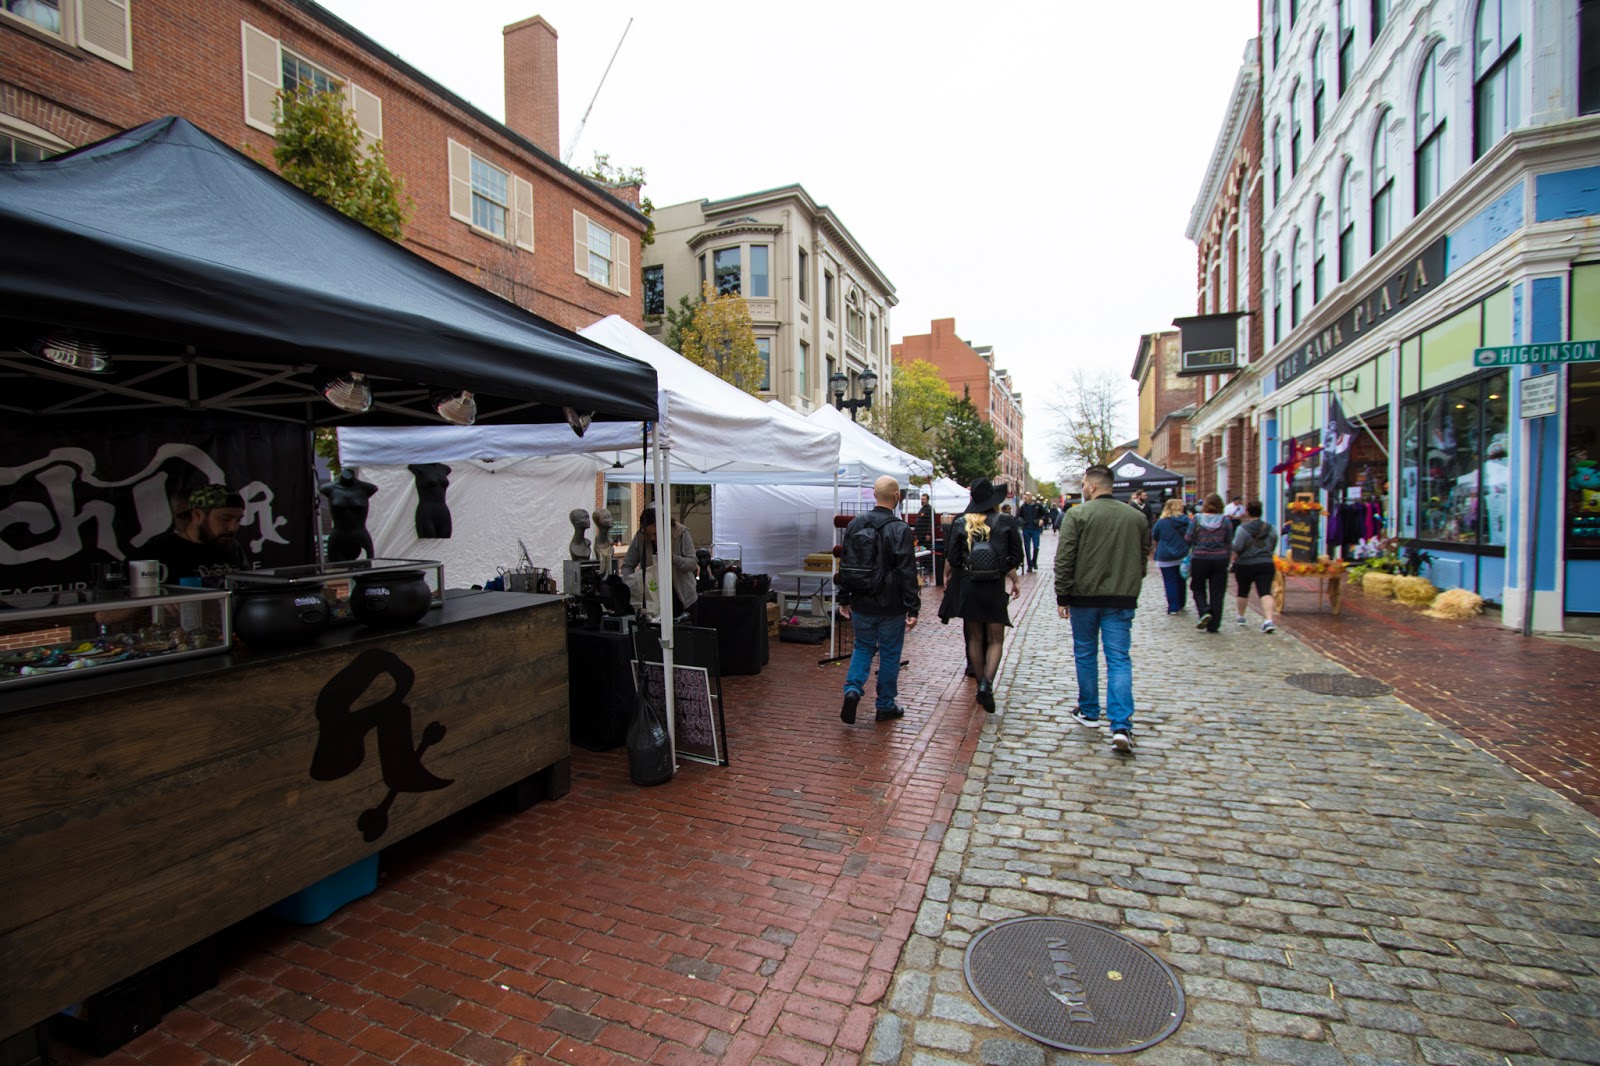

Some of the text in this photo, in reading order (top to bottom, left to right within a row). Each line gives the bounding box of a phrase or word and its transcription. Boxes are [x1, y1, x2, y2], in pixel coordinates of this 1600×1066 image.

[1278, 259, 1429, 383] THE BANK PLAZA
[1501, 344, 1596, 364] HIGGINSON
[1044, 937, 1096, 1023] DRAIN
